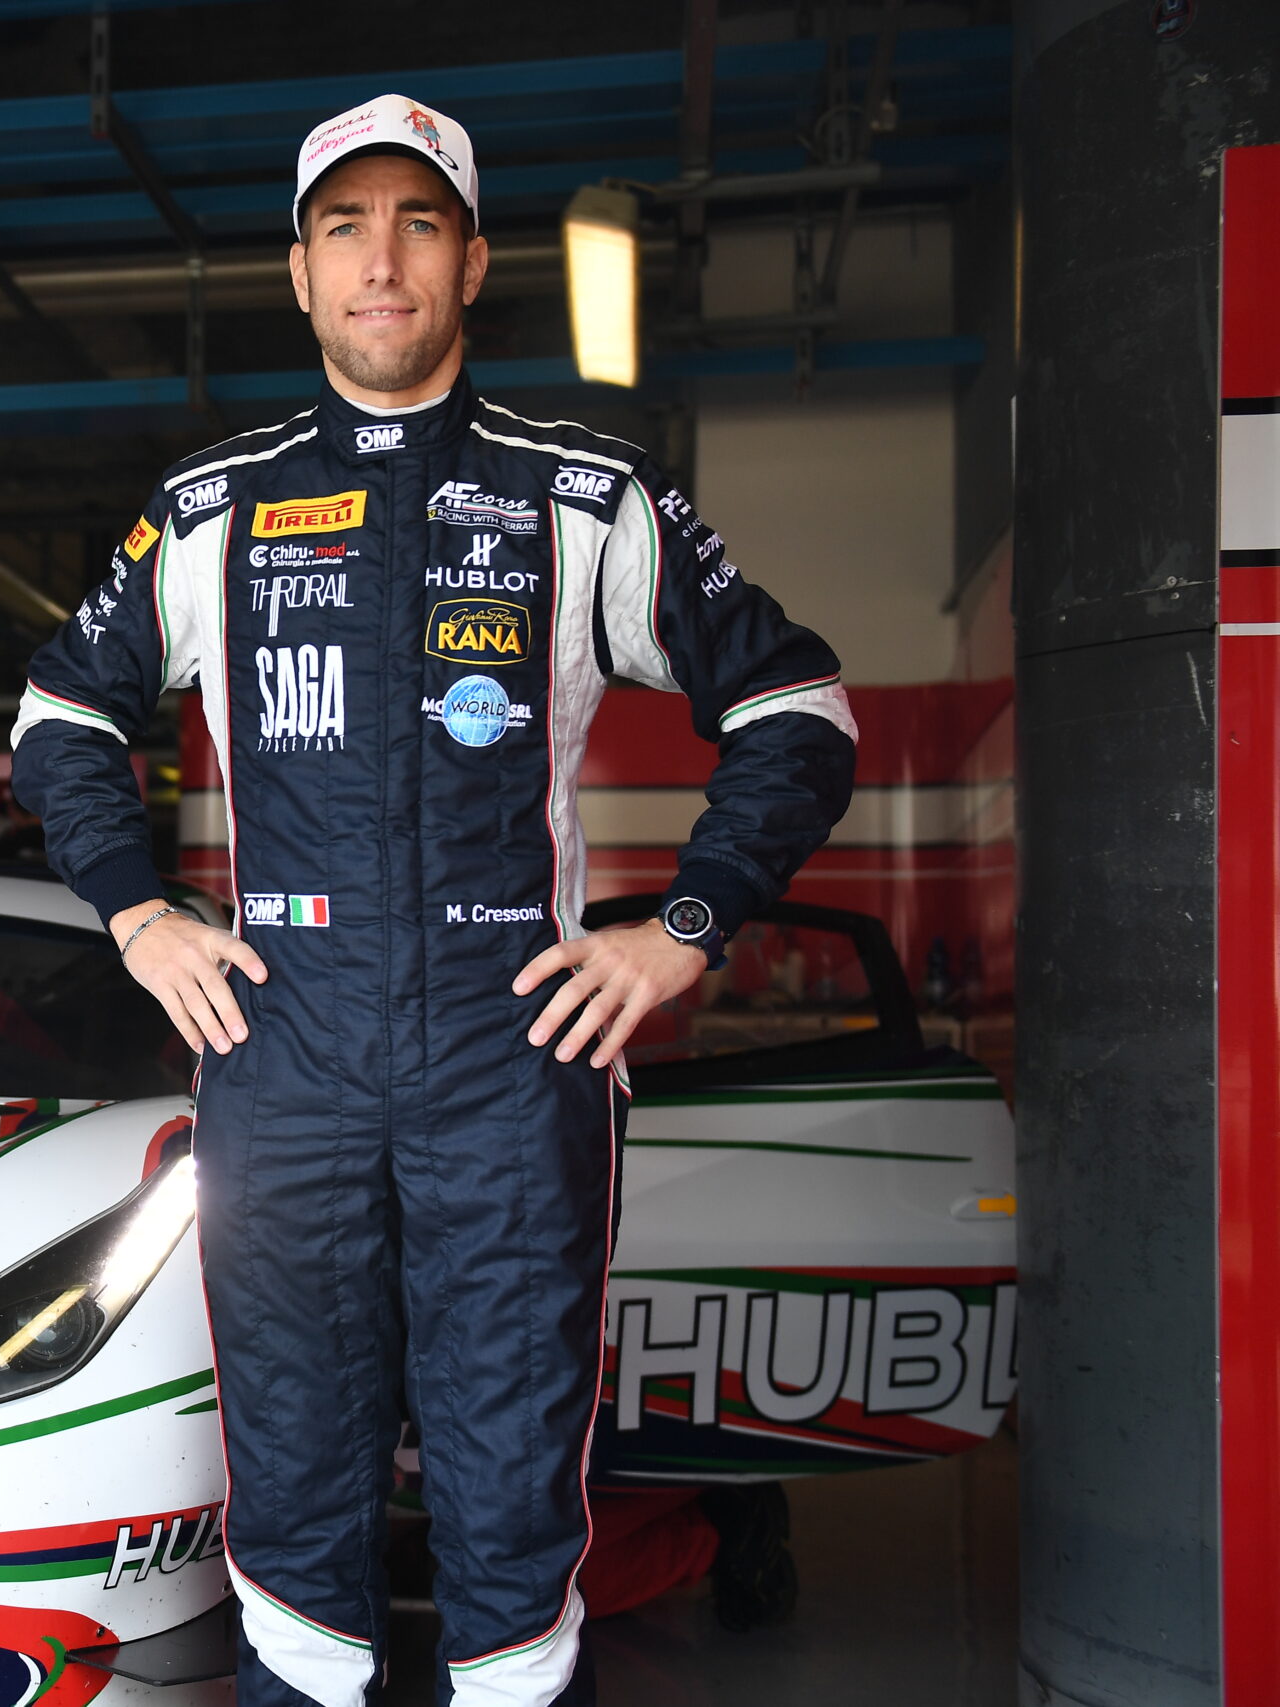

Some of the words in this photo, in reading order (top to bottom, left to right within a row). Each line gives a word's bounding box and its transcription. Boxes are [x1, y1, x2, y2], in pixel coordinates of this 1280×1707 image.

[308, 109, 378, 146] tomasi
[355, 428, 404, 450] OMP
[177, 479, 228, 512] OMP
[554, 471, 613, 497] OMP
[263, 498, 354, 531] PIRELLI
[437, 508, 470, 523] RACING
[472, 514, 499, 525] WITH
[501, 519, 538, 531] FERRARI
[426, 567, 539, 592] HUBLOT
[438, 622, 522, 655] RANA
[255, 643, 345, 738] SAGA
[452, 700, 506, 716] WORLD
[509, 703, 533, 719] SRL
[244, 897, 286, 921] OMP
[446, 904, 468, 923] M.
[471, 902, 544, 924] Cressoni
